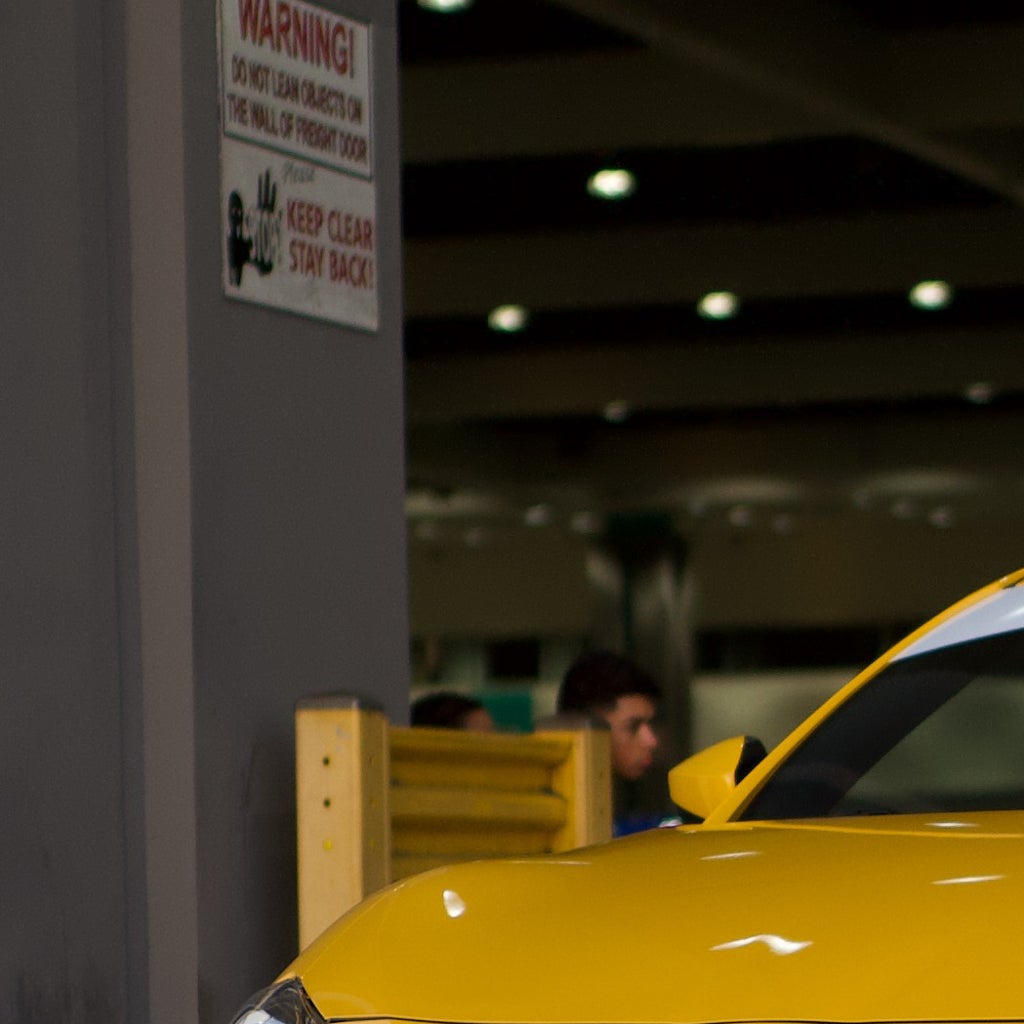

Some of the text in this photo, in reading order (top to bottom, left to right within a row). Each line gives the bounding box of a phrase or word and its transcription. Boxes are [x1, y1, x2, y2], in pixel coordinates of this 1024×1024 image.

[238, 0, 355, 79] WARNING!
[232, 54, 247, 86] DO
[250, 61, 270, 96] NOT
[272, 68, 299, 103] LEAN
[227, 93, 248, 126] THE
[250, 102, 278, 136] WALL
[280, 110, 294, 139] OF
[286, 199, 373, 250] KEEP CLEAR
[289, 239, 325, 278] STAY
